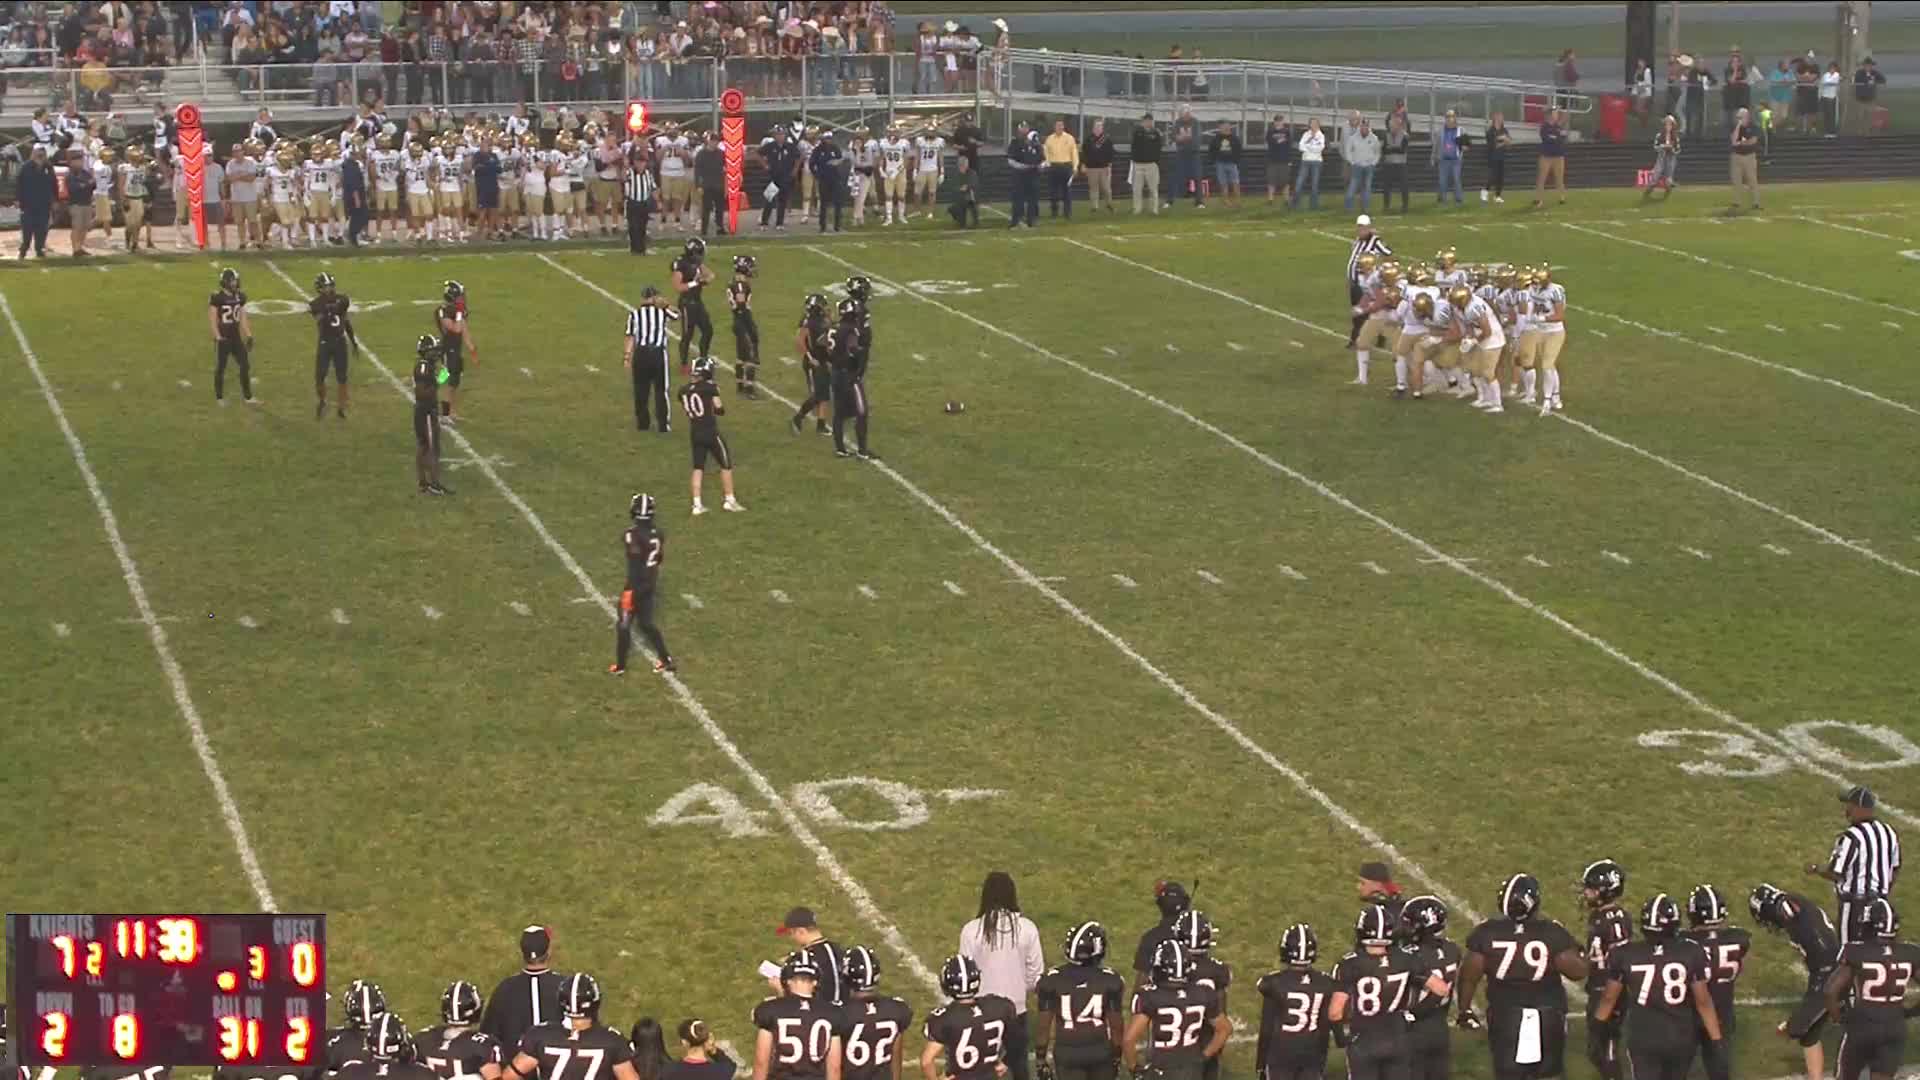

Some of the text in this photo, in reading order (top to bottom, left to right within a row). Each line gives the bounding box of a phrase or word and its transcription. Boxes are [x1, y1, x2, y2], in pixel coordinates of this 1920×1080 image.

[221, 304, 242, 323] 20
[682, 393, 704, 418] 10
[646, 538, 661, 567] 2
[1636, 719, 1920, 778] 30
[647, 775, 930, 838] 40
[1492, 940, 1549, 982] 79
[1862, 962, 1912, 1002] 23
[1356, 971, 1410, 1017] 87
[1630, 962, 1687, 1005] 78
[1060, 993, 1104, 1030] 14
[1154, 1004, 1206, 1048] 32
[1281, 991, 1324, 1032] 31
[776, 1018, 832, 1063] 50
[845, 1020, 898, 1066] 62
[955, 1019, 1004, 1069] 63
[544, 1047, 604, 1080] 77
